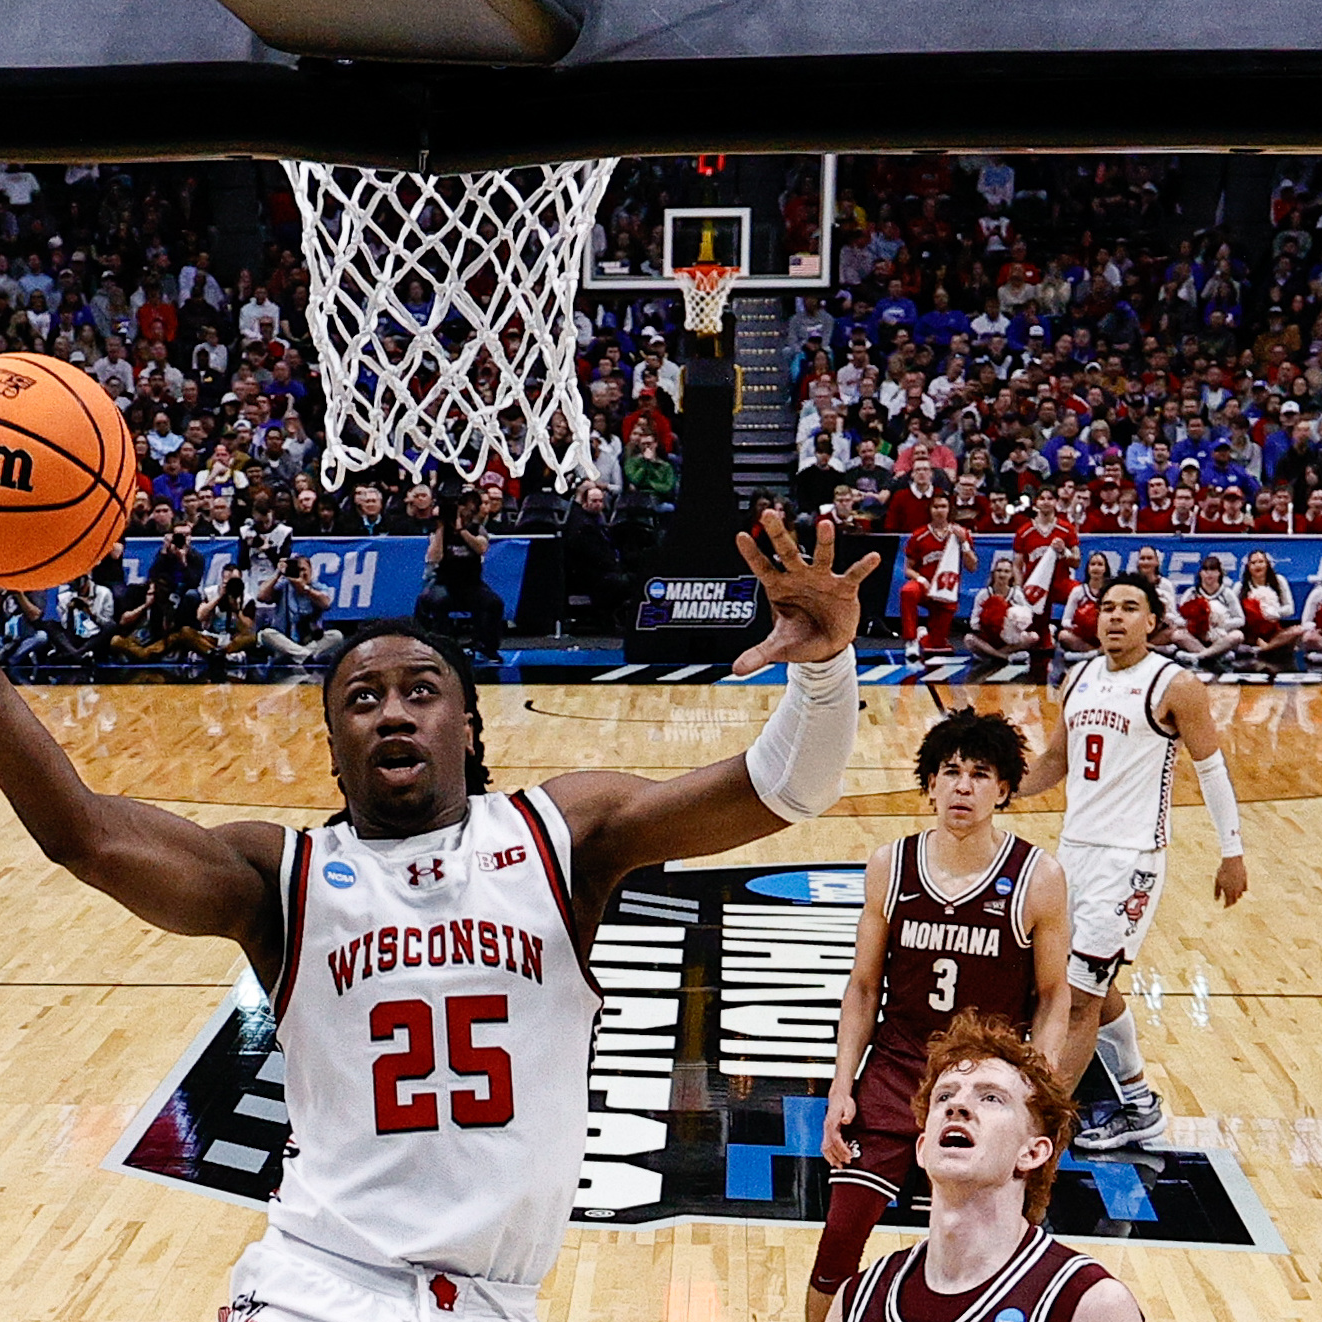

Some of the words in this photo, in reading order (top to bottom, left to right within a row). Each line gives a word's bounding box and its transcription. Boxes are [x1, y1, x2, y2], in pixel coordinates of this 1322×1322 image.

[665, 582, 726, 600] MARCH
[672, 601, 755, 619] MADNESS
[1068, 708, 1130, 736] WISCONSIN
[1084, 734, 1104, 781] 9
[328, 918, 543, 994] WISCONSIN
[900, 919, 1000, 957] MONTANA
[928, 958, 958, 1012] 3
[369, 994, 515, 1136] 25
